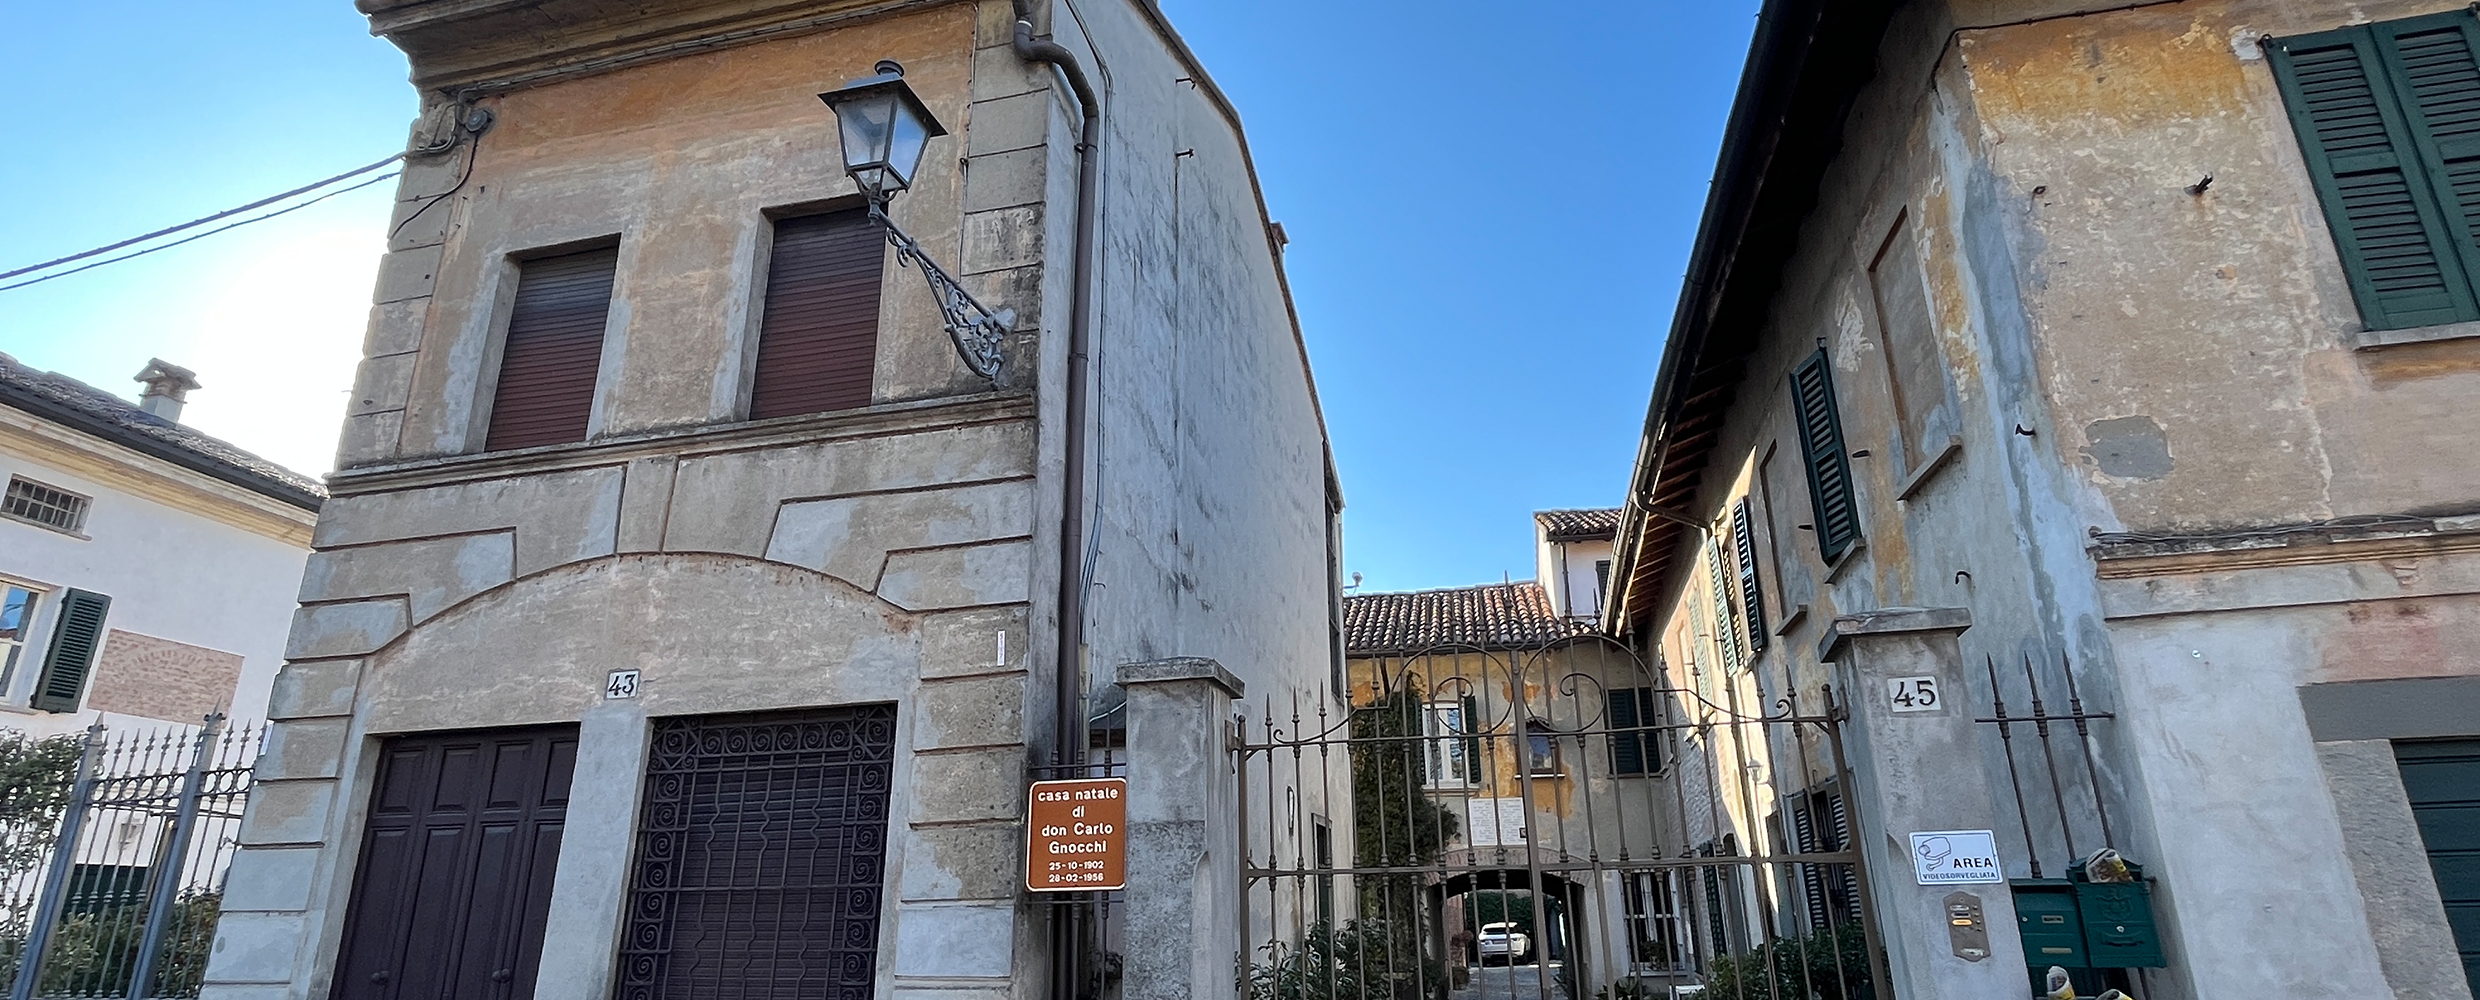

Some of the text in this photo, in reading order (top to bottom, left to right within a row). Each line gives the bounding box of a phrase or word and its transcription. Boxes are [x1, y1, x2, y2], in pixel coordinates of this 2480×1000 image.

[608, 674, 636, 696] 43
[1893, 680, 1936, 707] 45
[1037, 787, 1118, 801] casa natale
[1072, 805, 1085, 818] di
[1041, 822, 1113, 837] don Carlo
[1049, 840, 1107, 854] Gnocchi
[1953, 857, 1993, 869] AREA
[1922, 871, 1997, 880] VIDEOSORVEGLIATA
